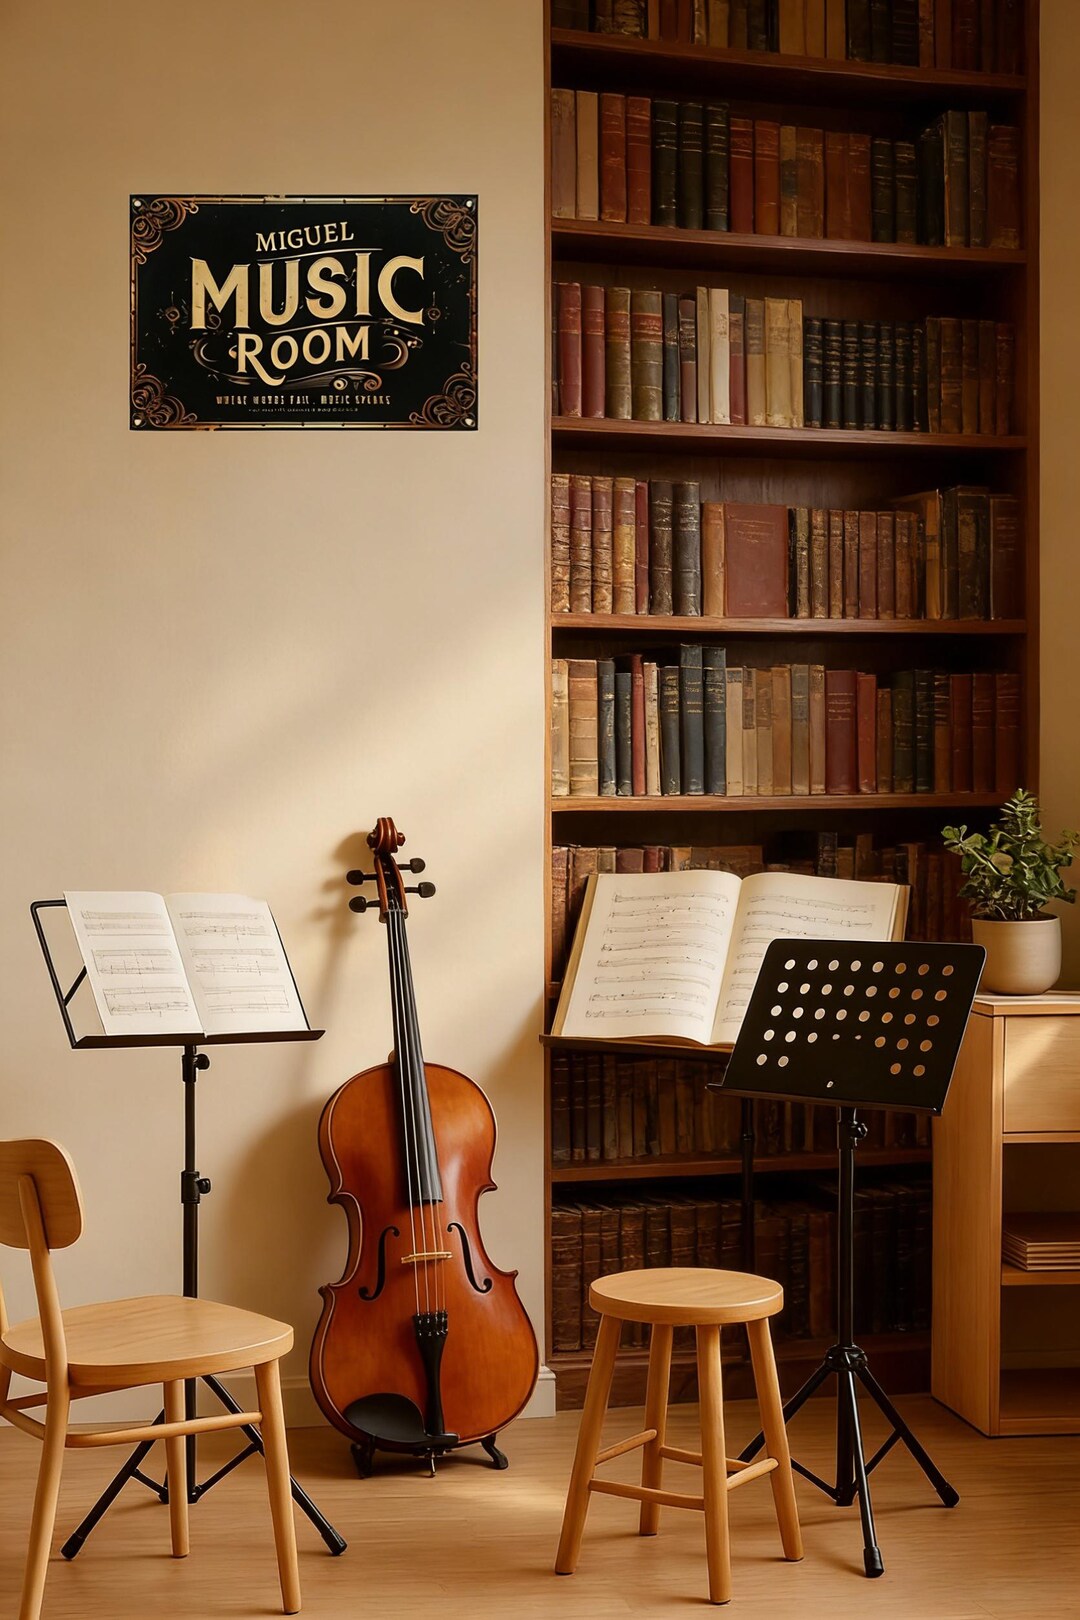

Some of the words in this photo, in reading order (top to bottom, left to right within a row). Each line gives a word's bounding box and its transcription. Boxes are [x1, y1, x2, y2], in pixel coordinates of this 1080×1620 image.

[255, 221, 355, 253] MIGUEL
[189, 251, 426, 330] MUSIC
[236, 324, 370, 387] ROOM
